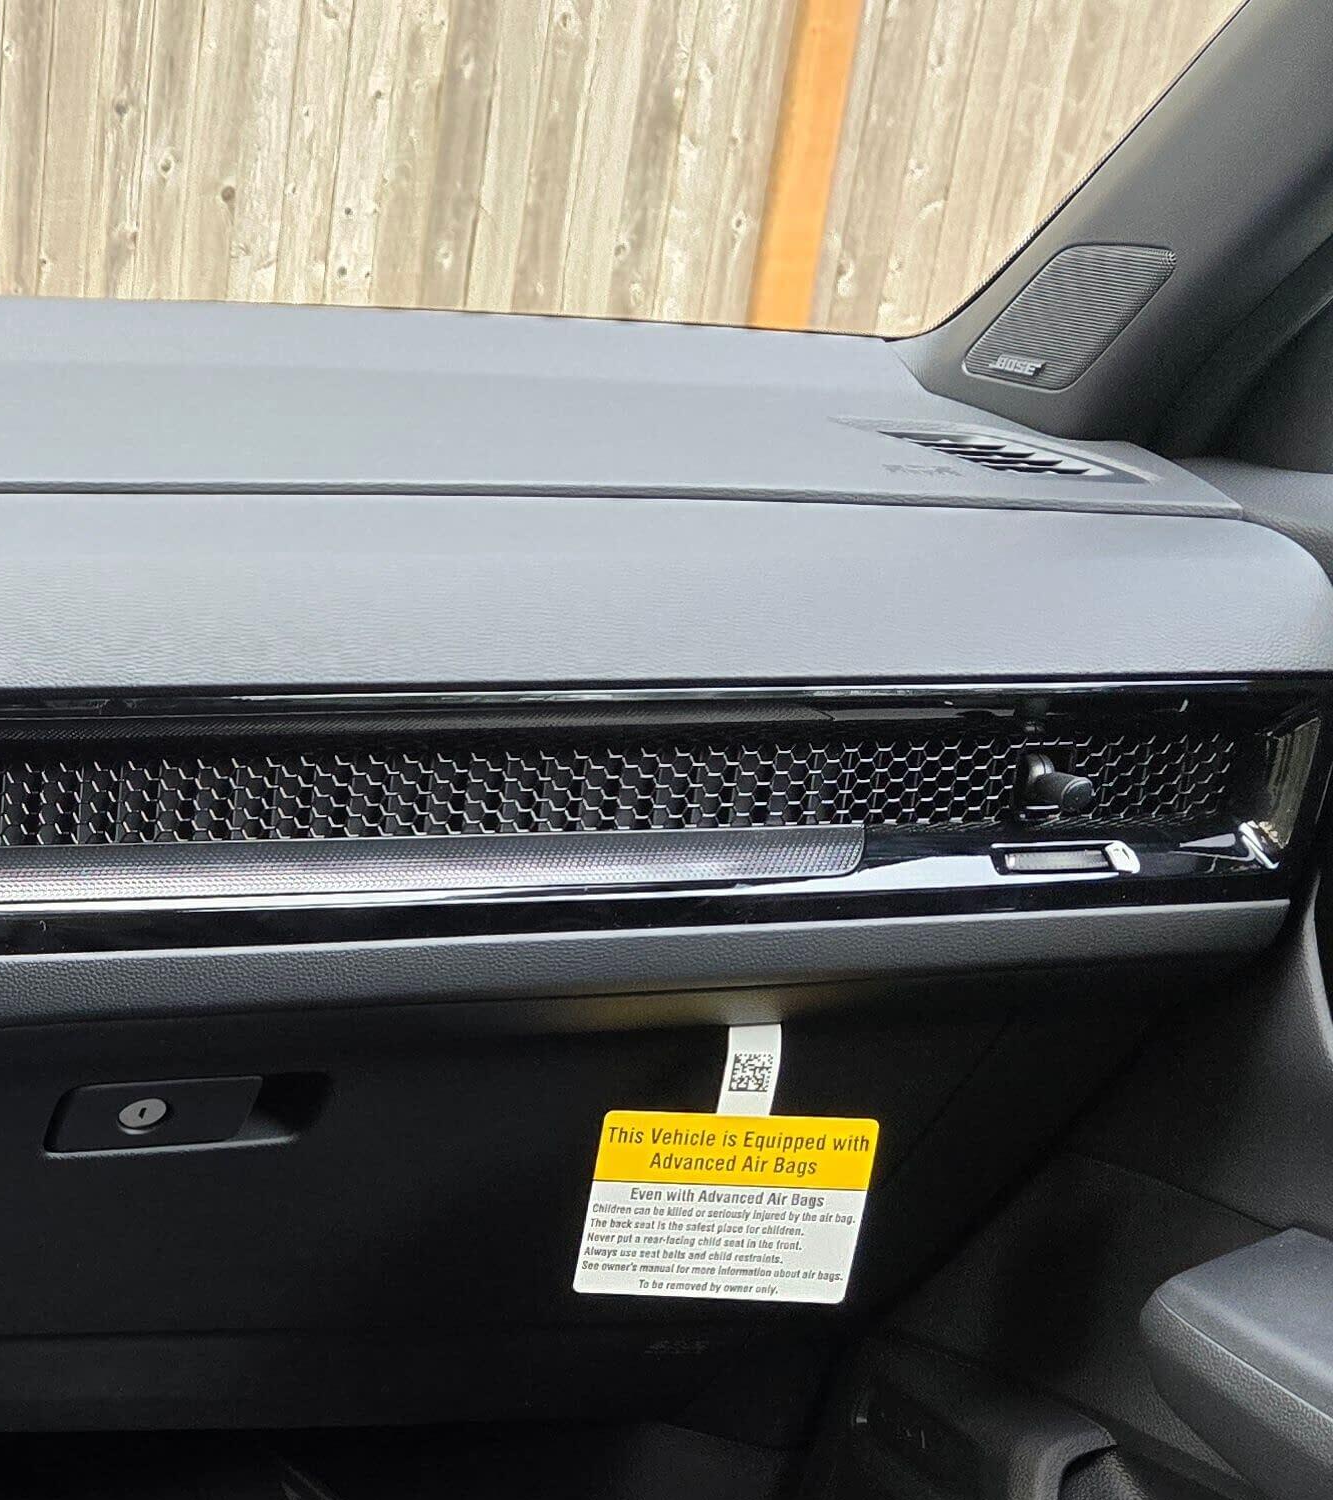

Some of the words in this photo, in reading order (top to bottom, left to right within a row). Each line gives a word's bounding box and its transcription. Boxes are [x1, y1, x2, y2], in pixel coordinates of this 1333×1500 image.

[989, 354, 1042, 376] BOSE
[609, 1127, 644, 1144] This
[652, 1128, 716, 1147] Vehicle
[722, 1131, 738, 1147] is
[743, 1131, 827, 1153] Equipped
[833, 1135, 870, 1152] with
[649, 1152, 737, 1172] Advanced
[741, 1156, 769, 1173] Air
[773, 1157, 818, 1178] Bags
[630, 1187, 663, 1201] Even
[667, 1189, 695, 1202] with
[697, 1190, 765, 1205] Advanced
[766, 1192, 788, 1206] Air
[791, 1193, 825, 1209] Bags
[592, 1203, 632, 1214] Children
[633, 1207, 651, 1216] can
[653, 1206, 665, 1217] be
[666, 1206, 694, 1218] killed
[695, 1210, 706, 1218] or
[707, 1209, 751, 1222] seriously
[752, 1209, 787, 1222] injured
[788, 1211, 801, 1224] by
[802, 1212, 818, 1222] the
[819, 1212, 834, 1223] air
[835, 1213, 856, 1226] bag.
[591, 1218, 608, 1228] The
[609, 1218, 633, 1229] back
[634, 1220, 655, 1230] seat
[657, 1221, 666, 1231] is
[668, 1221, 684, 1231] the
[685, 1222, 716, 1233] safest
[716, 1223, 744, 1235] place
[746, 1224, 761, 1235] for
[761, 1225, 805, 1237] children.
[581, 1260, 600, 1271] See
[601, 1262, 638, 1272] owner's
[639, 1264, 675, 1273] manual
[676, 1264, 690, 1274] for
[691, 1267, 716, 1275] more
[718, 1265, 772, 1277] information
[773, 1269, 801, 1279] about
[802, 1270, 816, 1280] air
[817, 1270, 844, 1283] bags.
[639, 1279, 650, 1289] To
[651, 1279, 664, 1290] be
[666, 1282, 709, 1292] removed
[709, 1282, 722, 1294] by
[723, 1284, 754, 1293] owner
[755, 1284, 779, 1296] only.
